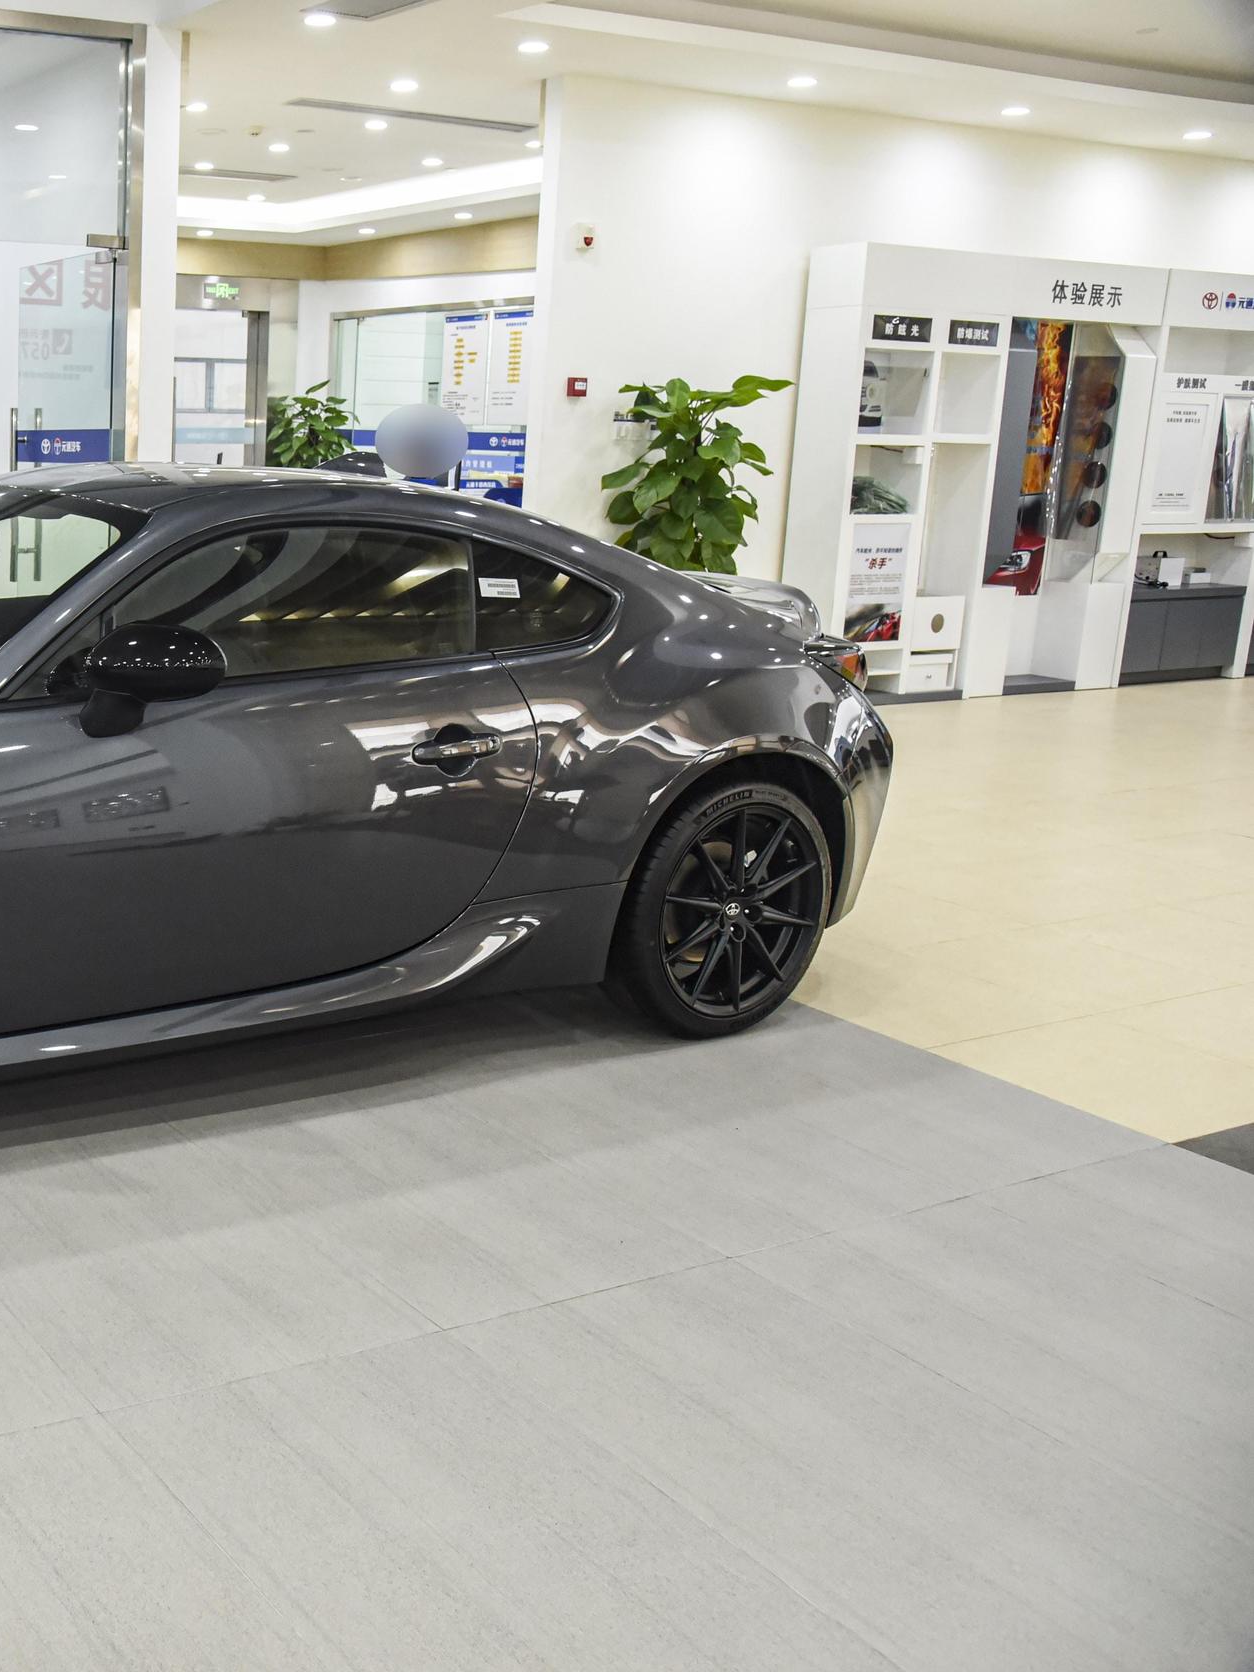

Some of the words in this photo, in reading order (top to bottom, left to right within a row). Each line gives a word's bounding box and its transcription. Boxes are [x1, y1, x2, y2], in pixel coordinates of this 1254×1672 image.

[1052, 279, 1123, 308] 体验展示
[885, 323, 920, 337] 防眩光
